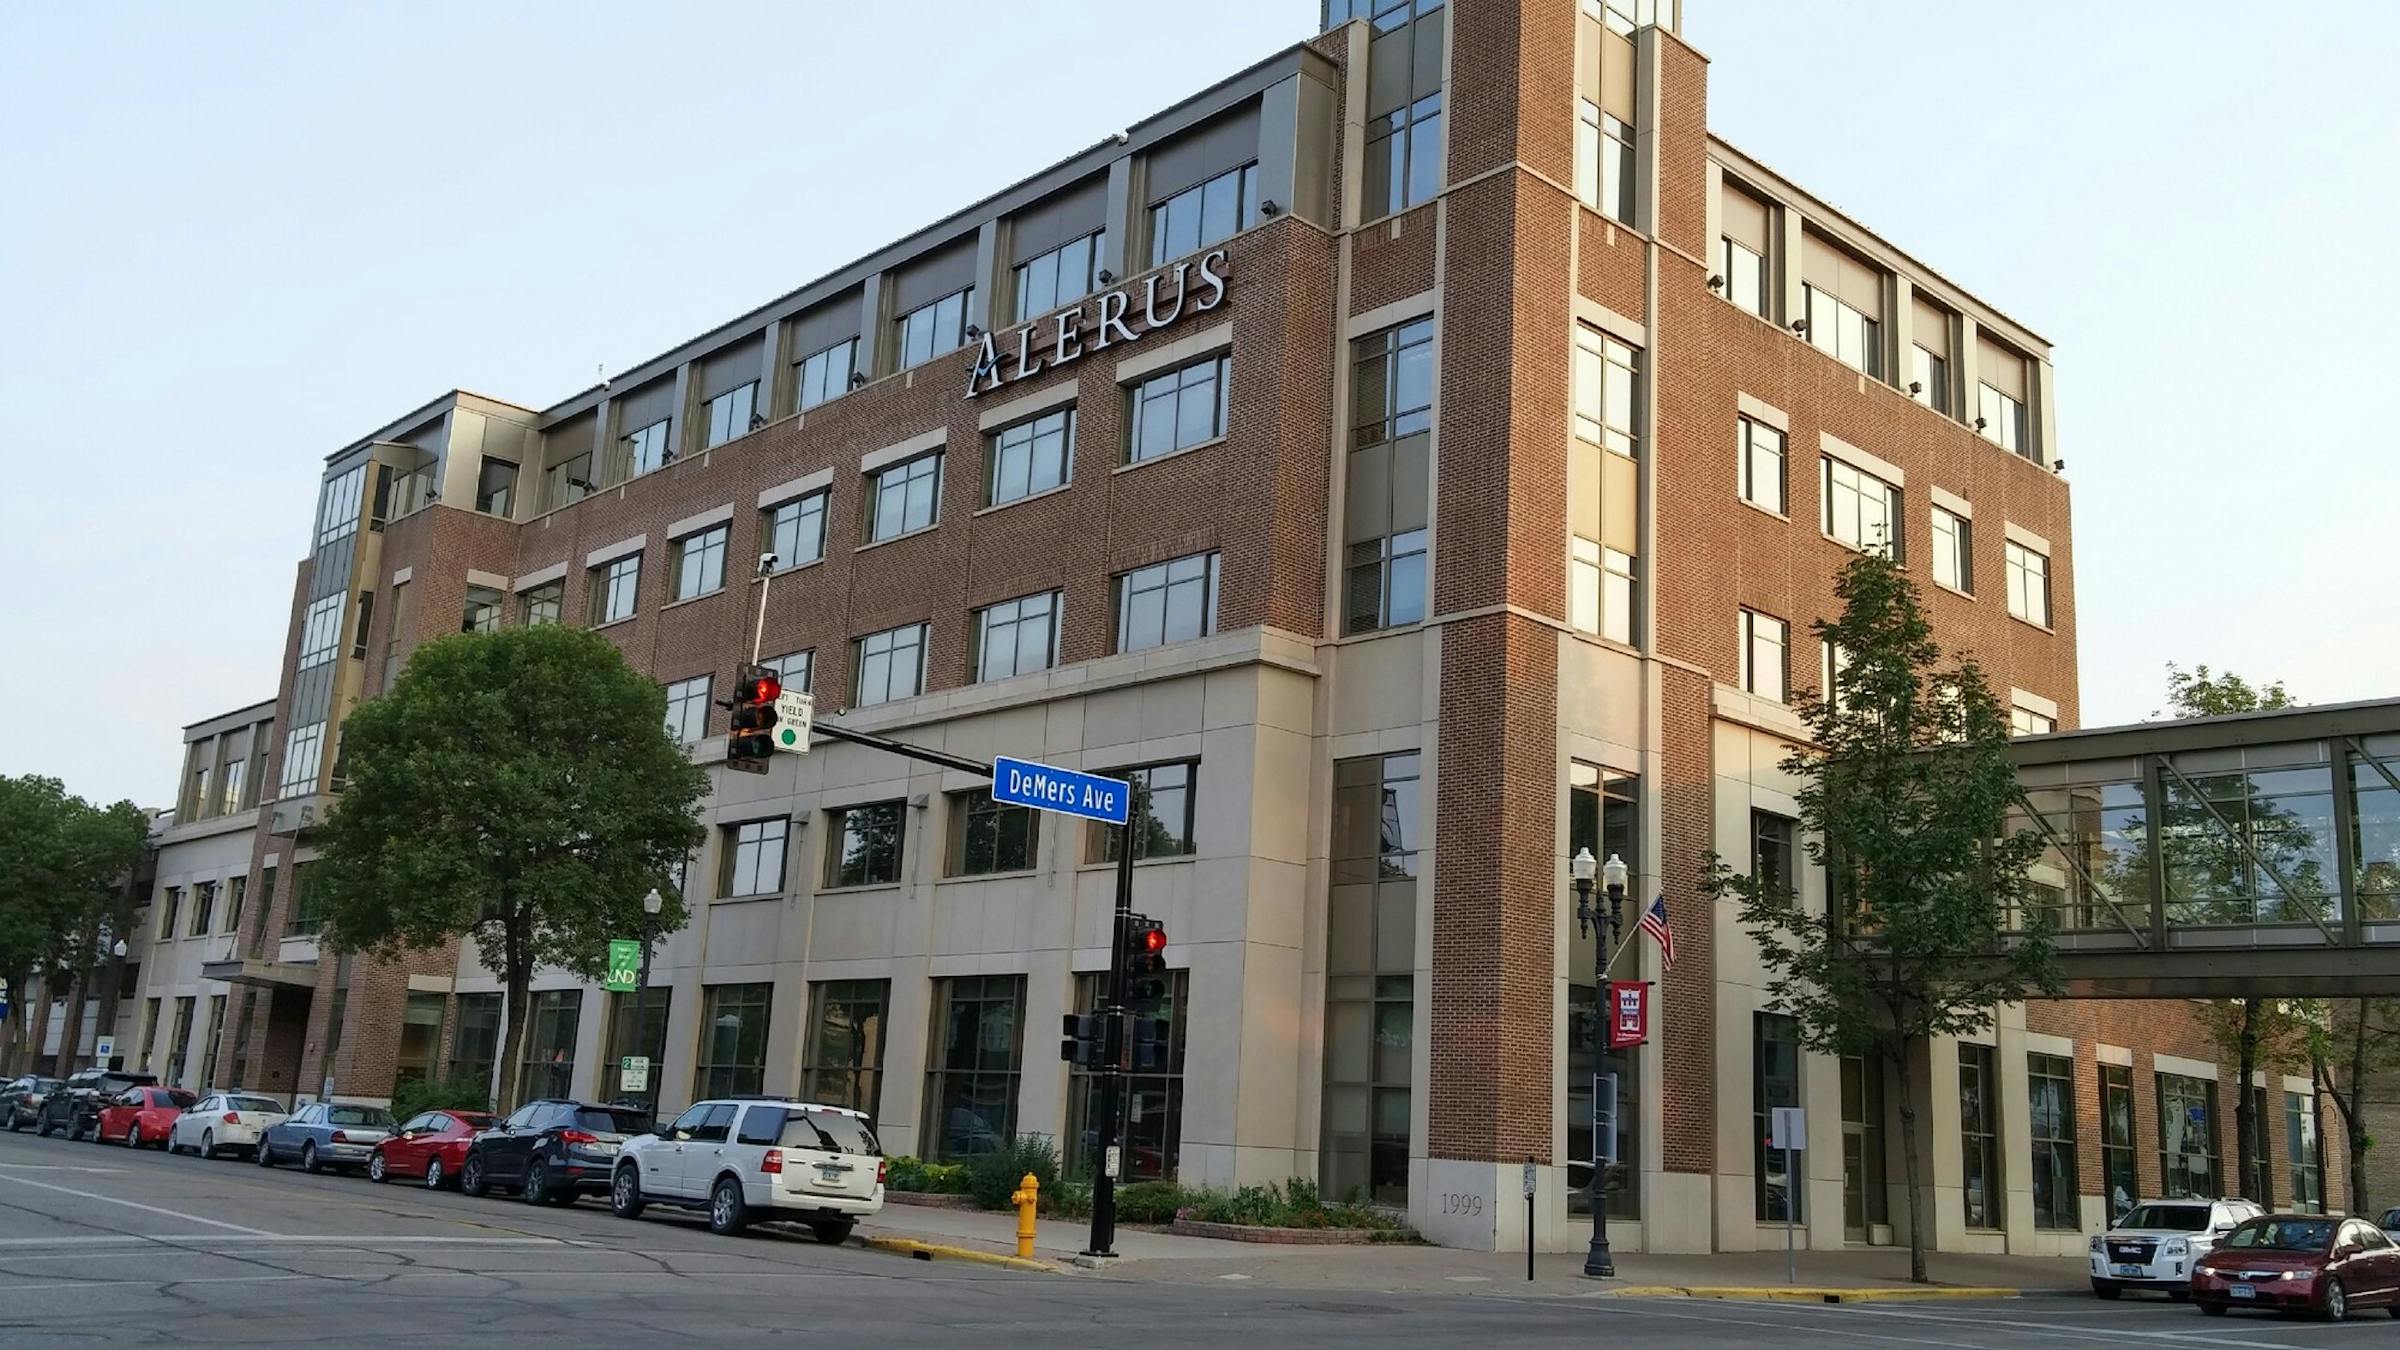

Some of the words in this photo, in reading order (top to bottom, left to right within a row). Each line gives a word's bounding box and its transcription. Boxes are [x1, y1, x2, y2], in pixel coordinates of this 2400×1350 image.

[963, 250, 1229, 400] ALERUS
[781, 703, 804, 717] YIELD
[787, 718, 807, 728] GREEN
[1009, 768, 1075, 805] DeMers
[1082, 783, 1114, 812] Ave
[607, 968, 635, 984] UND
[1442, 1193, 1483, 1216] 1999
[2118, 1246, 2142, 1254] GMC
